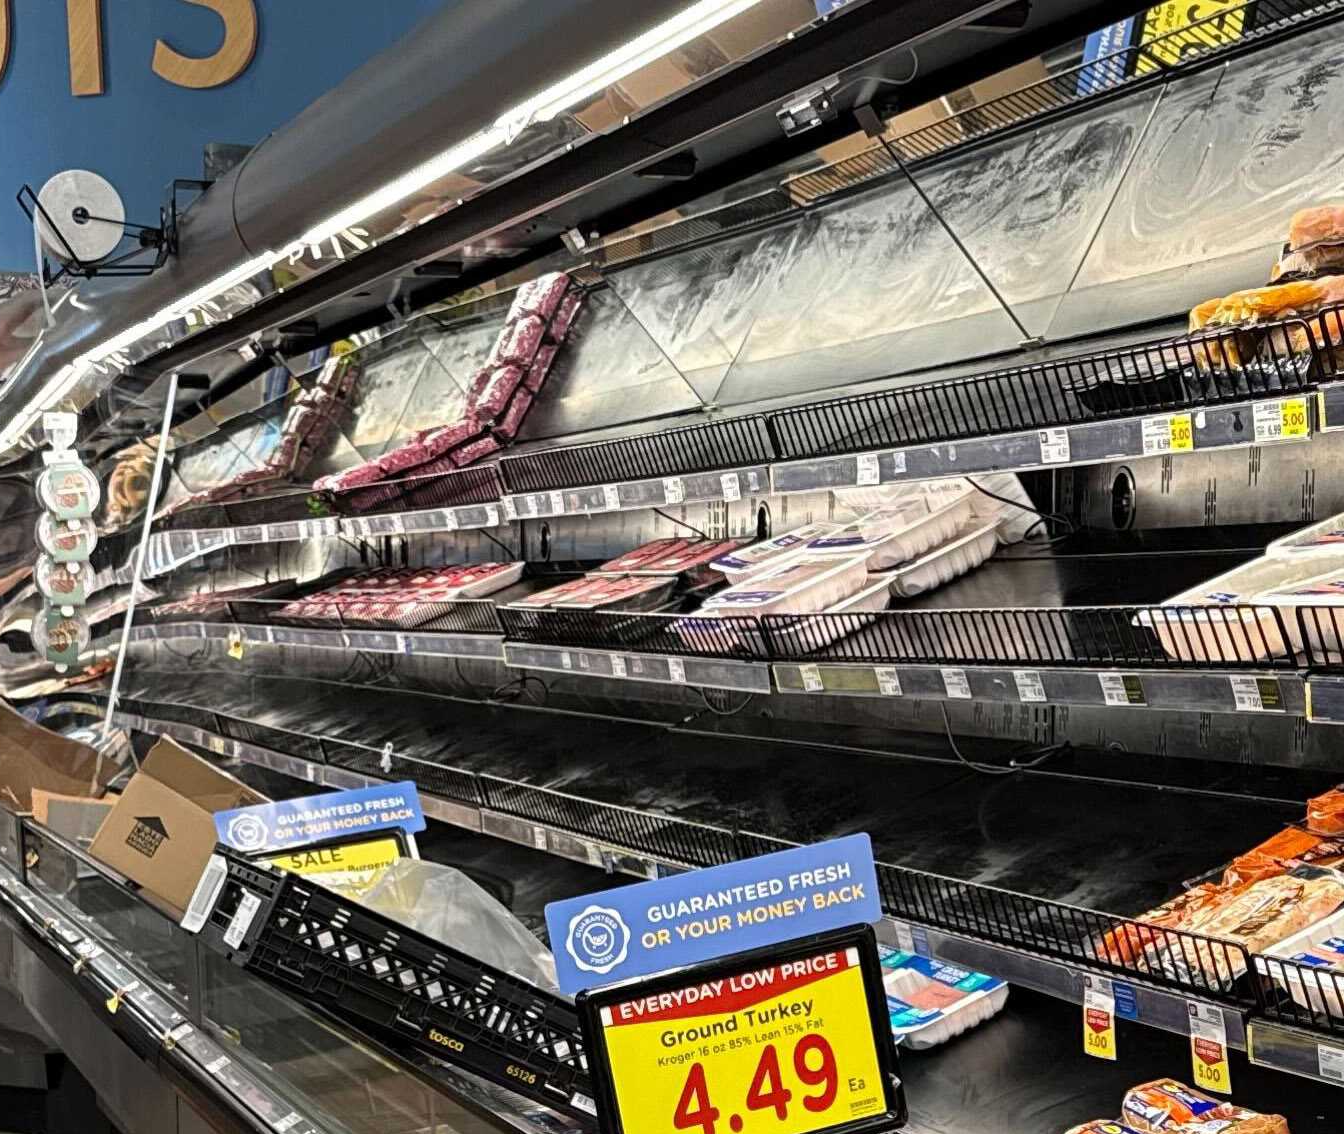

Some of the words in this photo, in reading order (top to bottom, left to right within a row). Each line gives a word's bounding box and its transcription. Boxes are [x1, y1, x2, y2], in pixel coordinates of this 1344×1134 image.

[1282, 412, 1305, 427] 5.00
[1170, 426, 1191, 442] 5.00
[277, 803, 363, 825] GUARANTEED
[364, 796, 405, 811] FRESH
[273, 826, 294, 840] OR
[296, 821, 332, 838] YOUR
[334, 815, 378, 831] MONEY
[380, 808, 416, 823] BACK
[290, 847, 344, 869] SALE
[646, 878, 785, 923] GUARANTEED
[788, 861, 852, 891] FRESH
[641, 927, 670, 949] OR
[675, 912, 732, 941] YOUR
[736, 898, 808, 928] MONEY
[812, 883, 866, 910] BACK
[618, 978, 725, 1020] EVERYDAY
[728, 967, 776, 994] LOW
[780, 952, 839, 981] PRICE
[660, 1015, 738, 1048] Ground
[743, 997, 814, 1027] Turkey
[428, 1027, 465, 1052] tosca
[657, 1049, 697, 1067] Kroger
[698, 1046, 710, 1059] 16
[712, 1043, 726, 1055] oz
[729, 1035, 753, 1051] 85%
[754, 1028, 781, 1045] Lean
[783, 1022, 804, 1038] 15%
[805, 1017, 825, 1033] Fat
[1088, 1033, 1107, 1049] 5.00
[506, 1064, 537, 1085] 65126
[849, 1077, 866, 1093] Ea
[1198, 1064, 1221, 1083] 5.00
